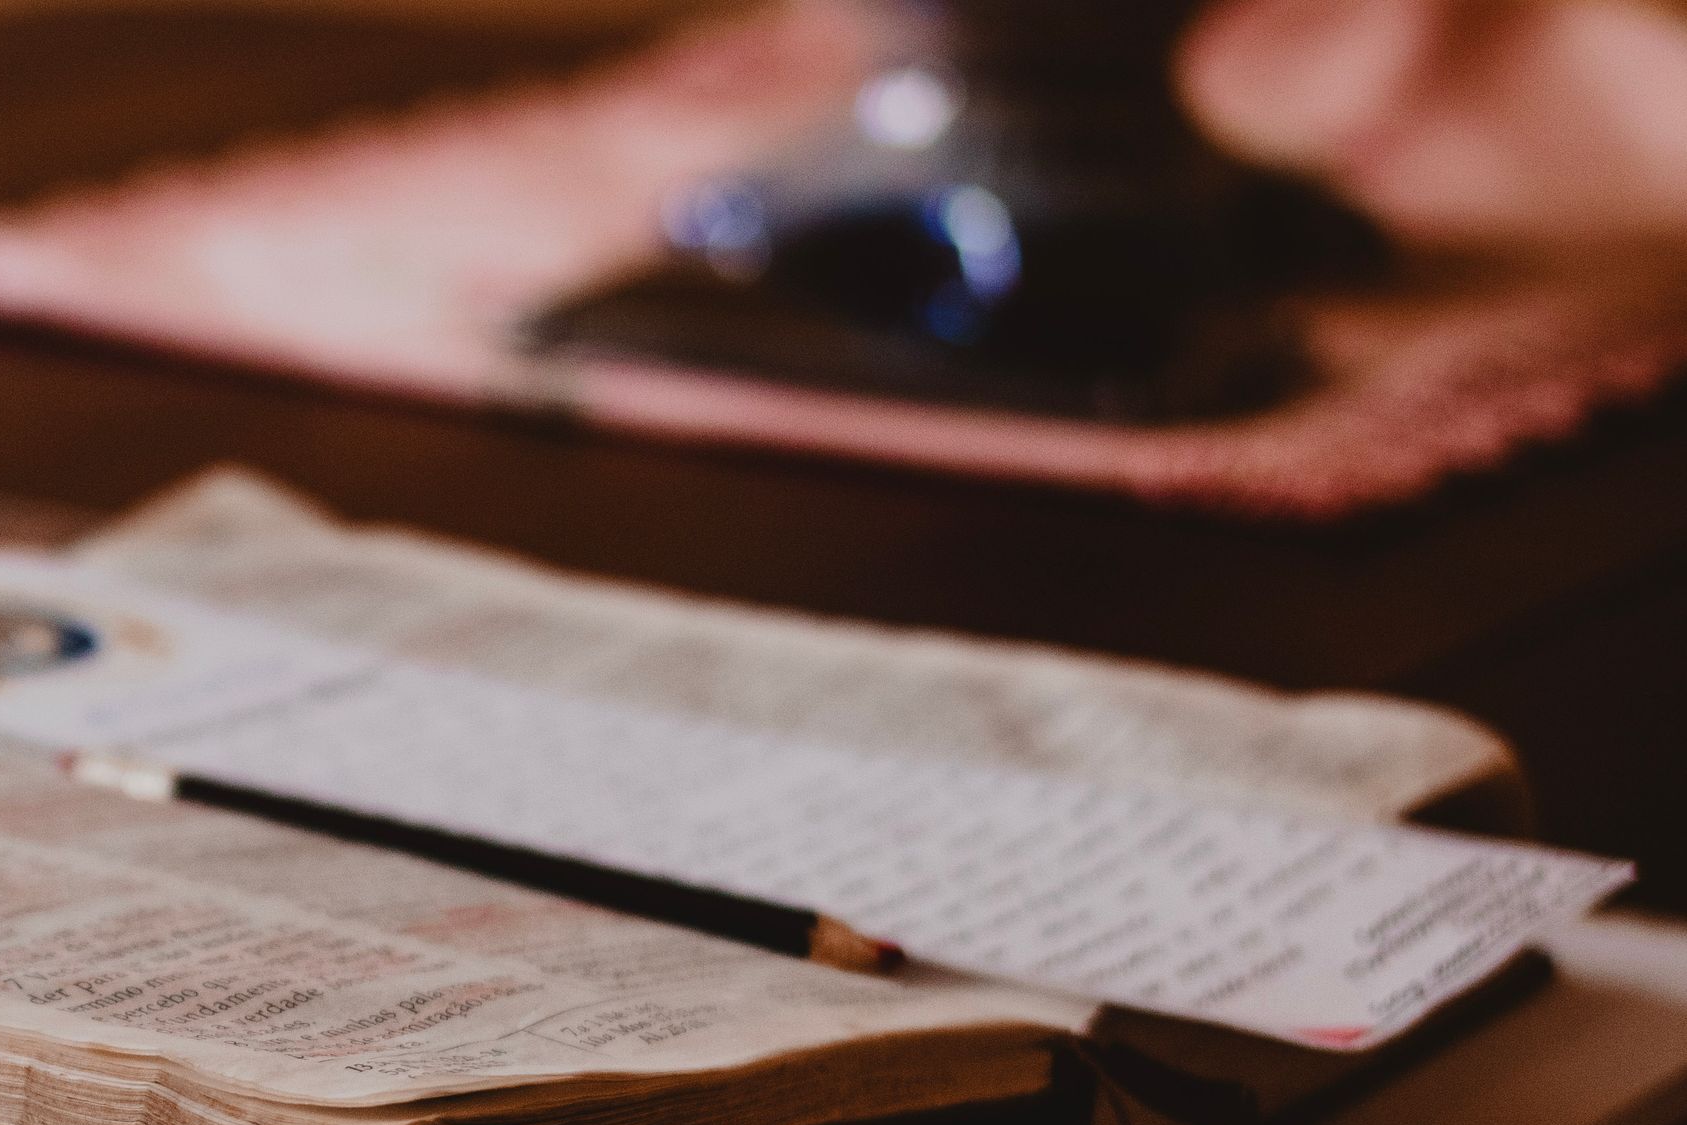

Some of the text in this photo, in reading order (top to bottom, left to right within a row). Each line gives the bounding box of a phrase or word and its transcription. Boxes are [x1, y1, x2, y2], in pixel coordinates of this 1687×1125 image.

[111, 988, 199, 1023] percebo
[231, 987, 325, 1027] verdade
[320, 1008, 397, 1039] minhas
